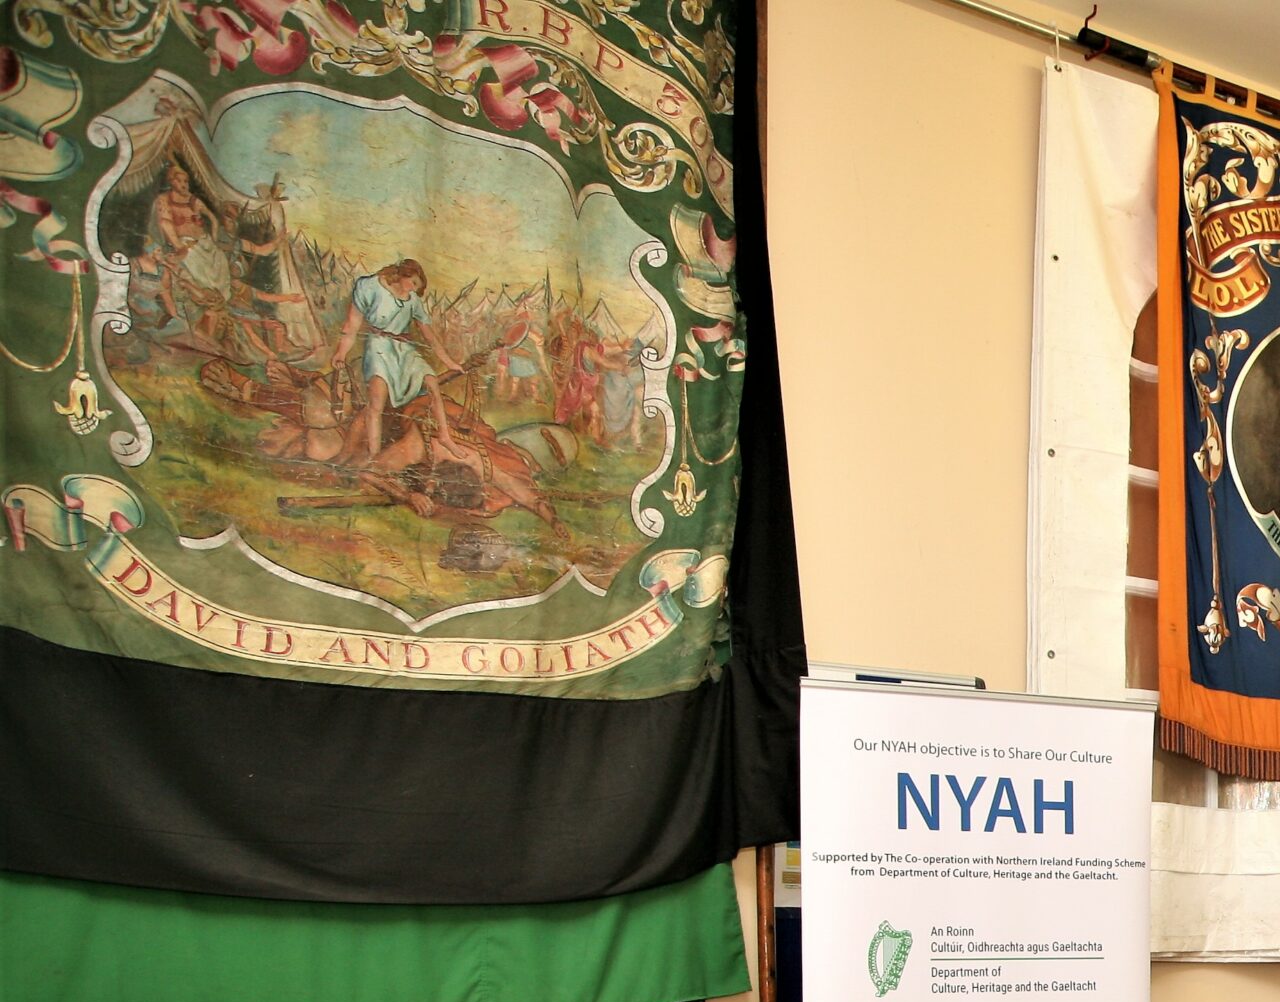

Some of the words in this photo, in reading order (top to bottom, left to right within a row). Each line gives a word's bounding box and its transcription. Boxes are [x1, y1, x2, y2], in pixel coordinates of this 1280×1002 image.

[1202, 217, 1232, 253] THE
[112, 556, 295, 658] DAVID
[319, 635, 430, 671] AND
[462, 604, 673, 675] GOLIATH
[854, 739, 877, 751] Our
[882, 740, 916, 753] NYAH
[920, 743, 977, 757] objective
[981, 746, 989, 757] is
[993, 748, 1005, 758] to
[1009, 747, 1042, 760] Share
[1045, 749, 1067, 761] Our
[1070, 751, 1112, 764] Culture
[897, 772, 1074, 835] NYAH
[813, 852, 868, 863] Supported
[871, 853, 883, 864] by
[884, 853, 902, 862] The
[972, 856, 993, 864] with
[996, 856, 1037, 865] Northern
[1040, 857, 1072, 866] Ireland
[1075, 858, 1112, 869] Funding
[1115, 859, 1146, 868] Scheme
[851, 866, 874, 876] from
[880, 867, 938, 878] Department
[941, 868, 950, 877] of
[953, 869, 991, 879] Culture,
[994, 870, 1032, 881] Heritage
[1035, 871, 1052, 879] and
[1055, 870, 1070, 879] the
[1073, 871, 1118, 880] Gaeltacht.
[931, 927, 943, 936] An
[947, 926, 974, 936] Roinn
[931, 942, 964, 953] Cultúir,
[968, 941, 1024, 952] Oidhreachta
[1027, 944, 1049, 954] agus
[1052, 941, 1102, 952] Gaeltachta
[931, 967, 988, 980] Department
[992, 966, 1001, 977] of
[932, 983, 968, 994] Culture,
[972, 982, 1012, 995] Heritage
[1015, 981, 1031, 992] and
[1034, 981, 1048, 991] the
[1052, 980, 1096, 991] Gaeltacht
